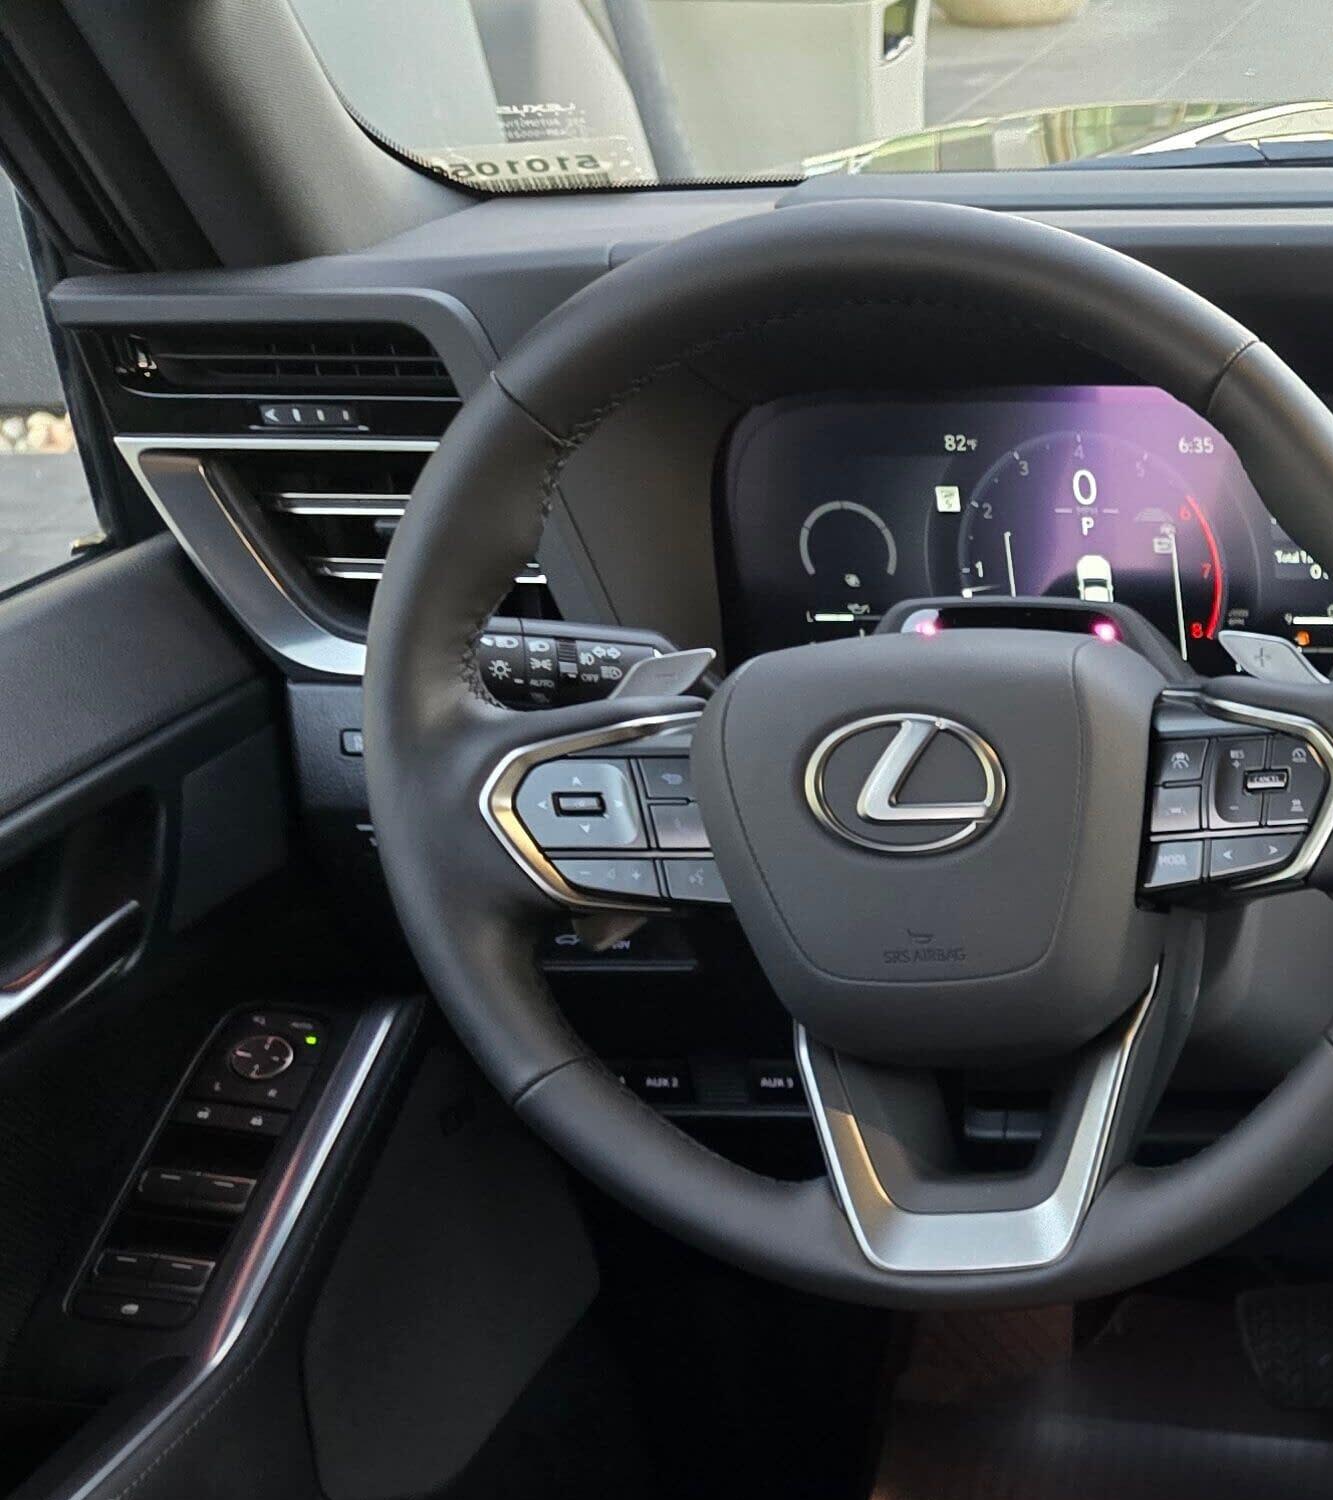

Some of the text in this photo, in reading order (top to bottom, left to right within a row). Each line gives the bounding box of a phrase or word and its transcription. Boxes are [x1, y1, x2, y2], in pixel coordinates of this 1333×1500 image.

[1178, 436, 1214, 453] 6:35
[1018, 460, 1030, 476] 3
[1072, 469, 1097, 505] 0
[982, 503, 993, 519] 2
[1179, 505, 1192, 521] 6
[1081, 516, 1095, 536] P
[974, 561, 984, 578] 1
[1190, 623, 1204, 638] 8
[529, 678, 555, 688] AUTO
[1253, 775, 1280, 783] CANCEL
[883, 946, 968, 964] SRS AIRBAG
[645, 1077, 669, 1088] AUX
[760, 1077, 785, 1088] AUX
